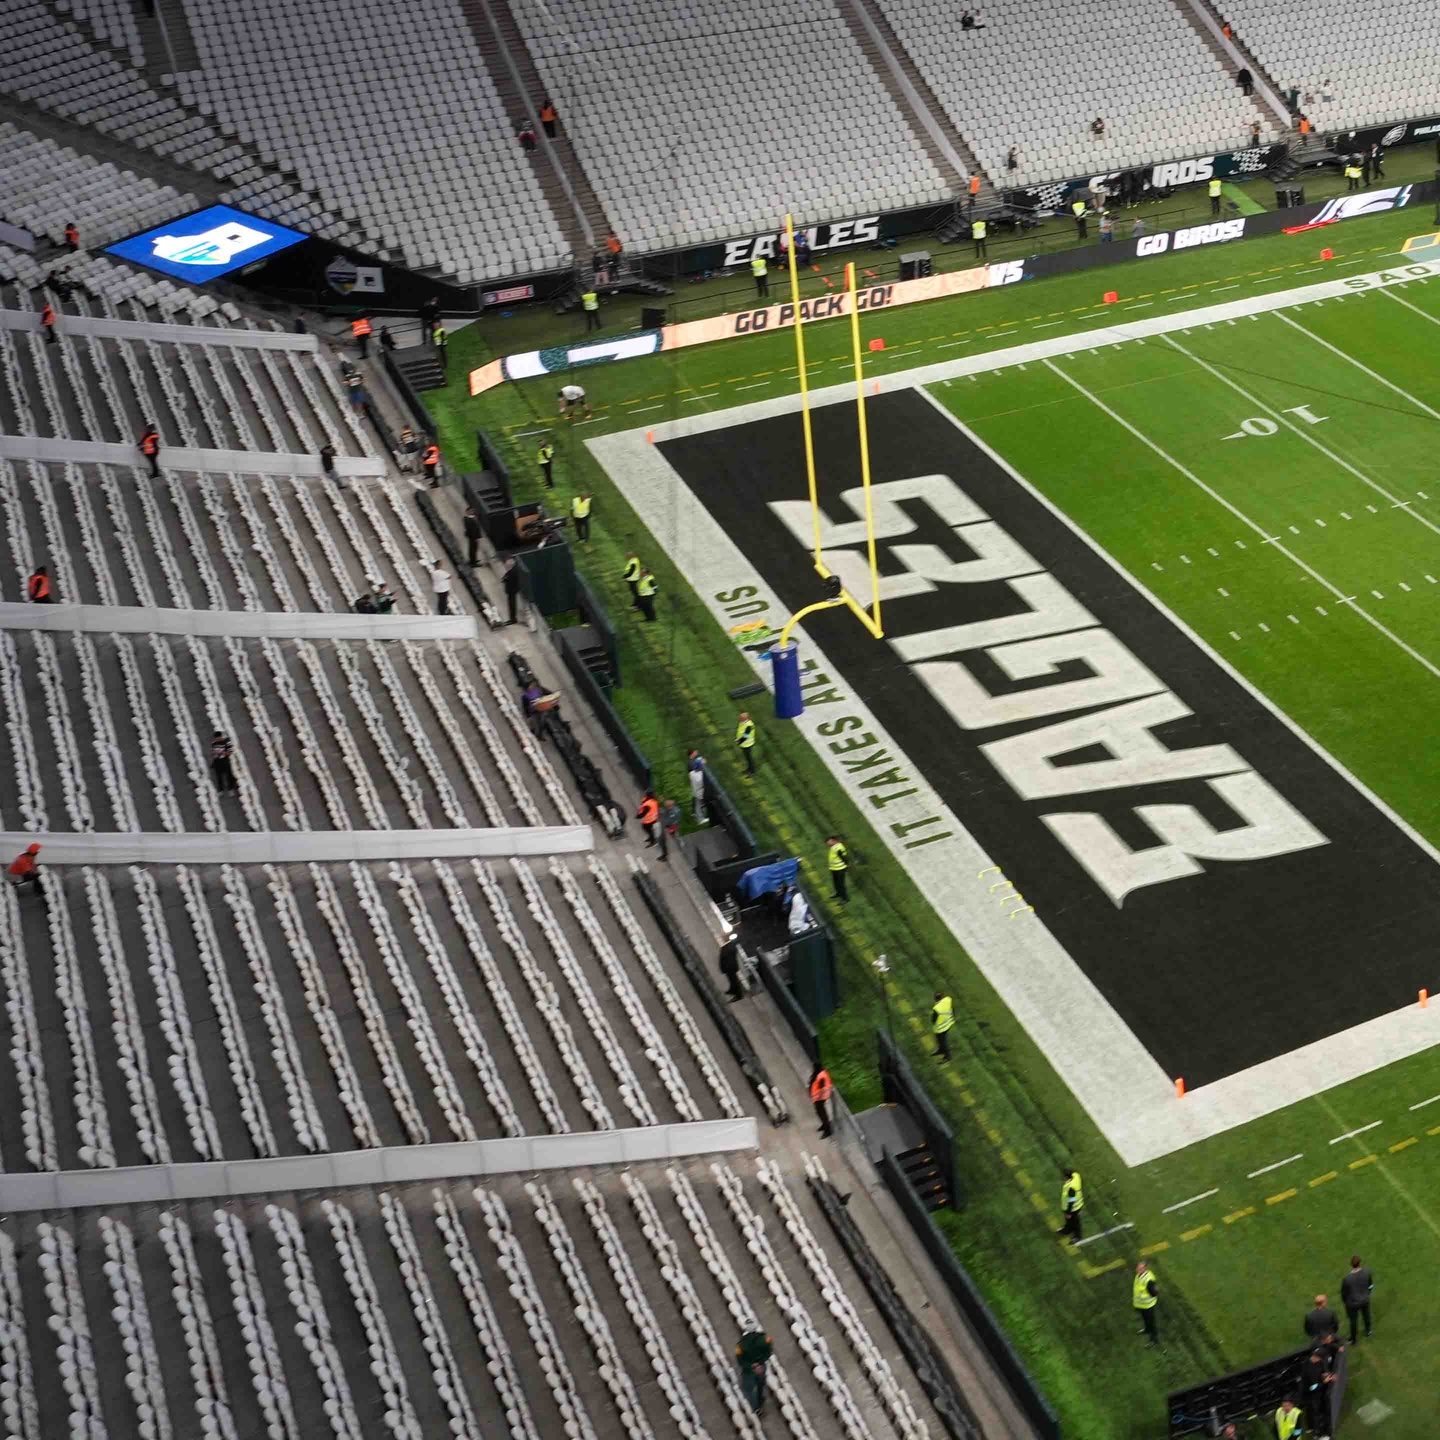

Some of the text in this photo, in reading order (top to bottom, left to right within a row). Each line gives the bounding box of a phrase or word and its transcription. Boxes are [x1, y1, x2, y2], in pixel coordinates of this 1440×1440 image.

[1152, 156, 1216, 188] IRDS
[724, 216, 880, 266] EALES
[1136, 218, 1247, 257] GO BIRDS!
[1343, 264, 1432, 290] SÃO
[735, 285, 894, 334] GO PACK GO!
[1240, 403, 1330, 436] 10
[715, 585, 771, 620] US
[767, 474, 1331, 910] EAGLES
[816, 715, 920, 810] TAKES
[890, 815, 955, 850] IT
